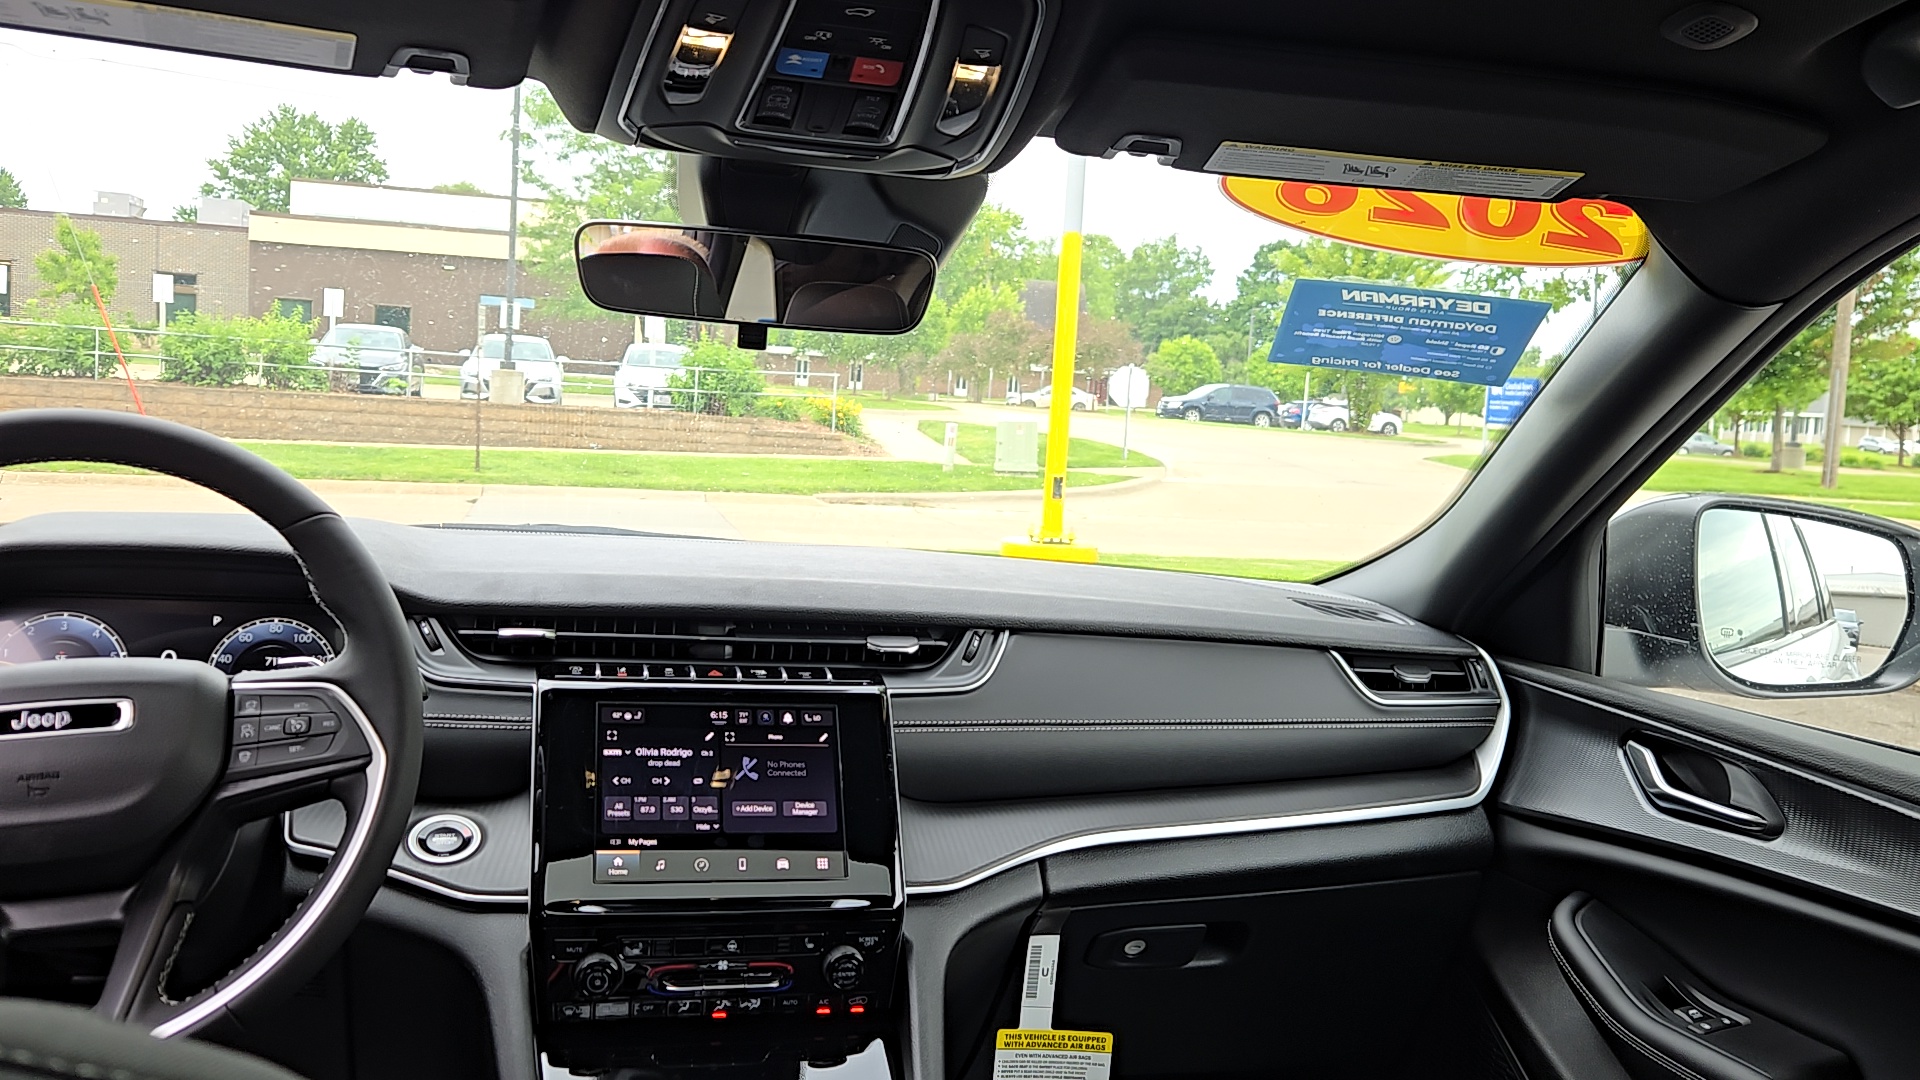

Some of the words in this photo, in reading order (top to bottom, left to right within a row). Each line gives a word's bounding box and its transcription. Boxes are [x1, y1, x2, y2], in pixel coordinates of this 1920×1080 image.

[1244, 144, 1295, 152] WARNING
[213, 616, 222, 626] P
[60, 622, 68, 630] 3
[269, 624, 283, 633] 80
[27, 626, 35, 636] 2
[92, 629, 100, 638] 4
[238, 632, 253, 642] 60
[293, 634, 312, 643] 100
[218, 654, 232, 664] 40
[710, 711, 728, 719] 6:15
[11, 711, 72, 730] Jeep
[635, 747, 659, 756] Olivia
[660, 747, 693, 758] Rodrigo
[648, 759, 663, 768] drop
[16, 771, 60, 782] AIRBAG
[767, 769, 806, 777] Connected
[639, 838, 658, 846] Pages
[1042, 967, 1049, 977] U
[1068, 1035, 1106, 1043] EQUIPPED
